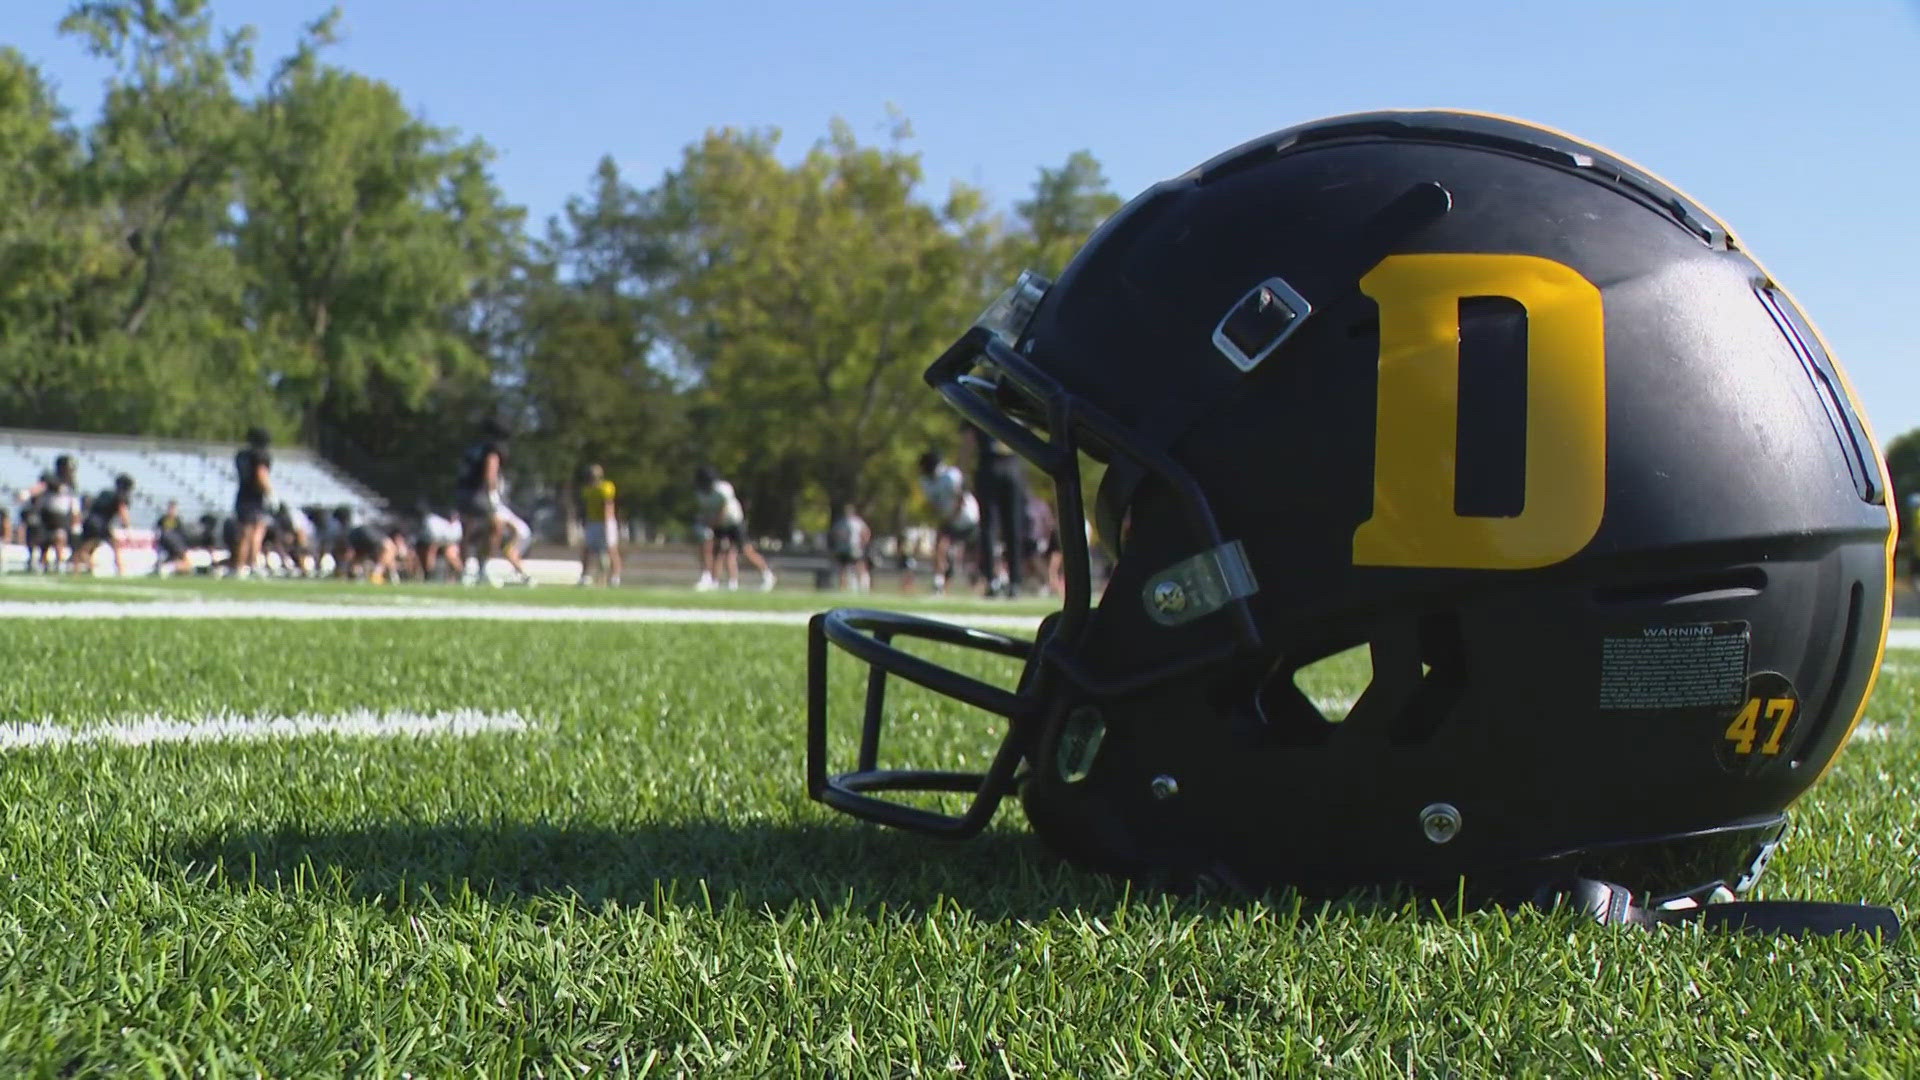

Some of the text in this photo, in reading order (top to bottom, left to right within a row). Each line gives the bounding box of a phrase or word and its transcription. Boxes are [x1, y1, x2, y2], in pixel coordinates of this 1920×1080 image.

[1352, 253, 1606, 570] D
[1643, 626, 1714, 638] WARNING
[1724, 697, 1795, 756] 47
